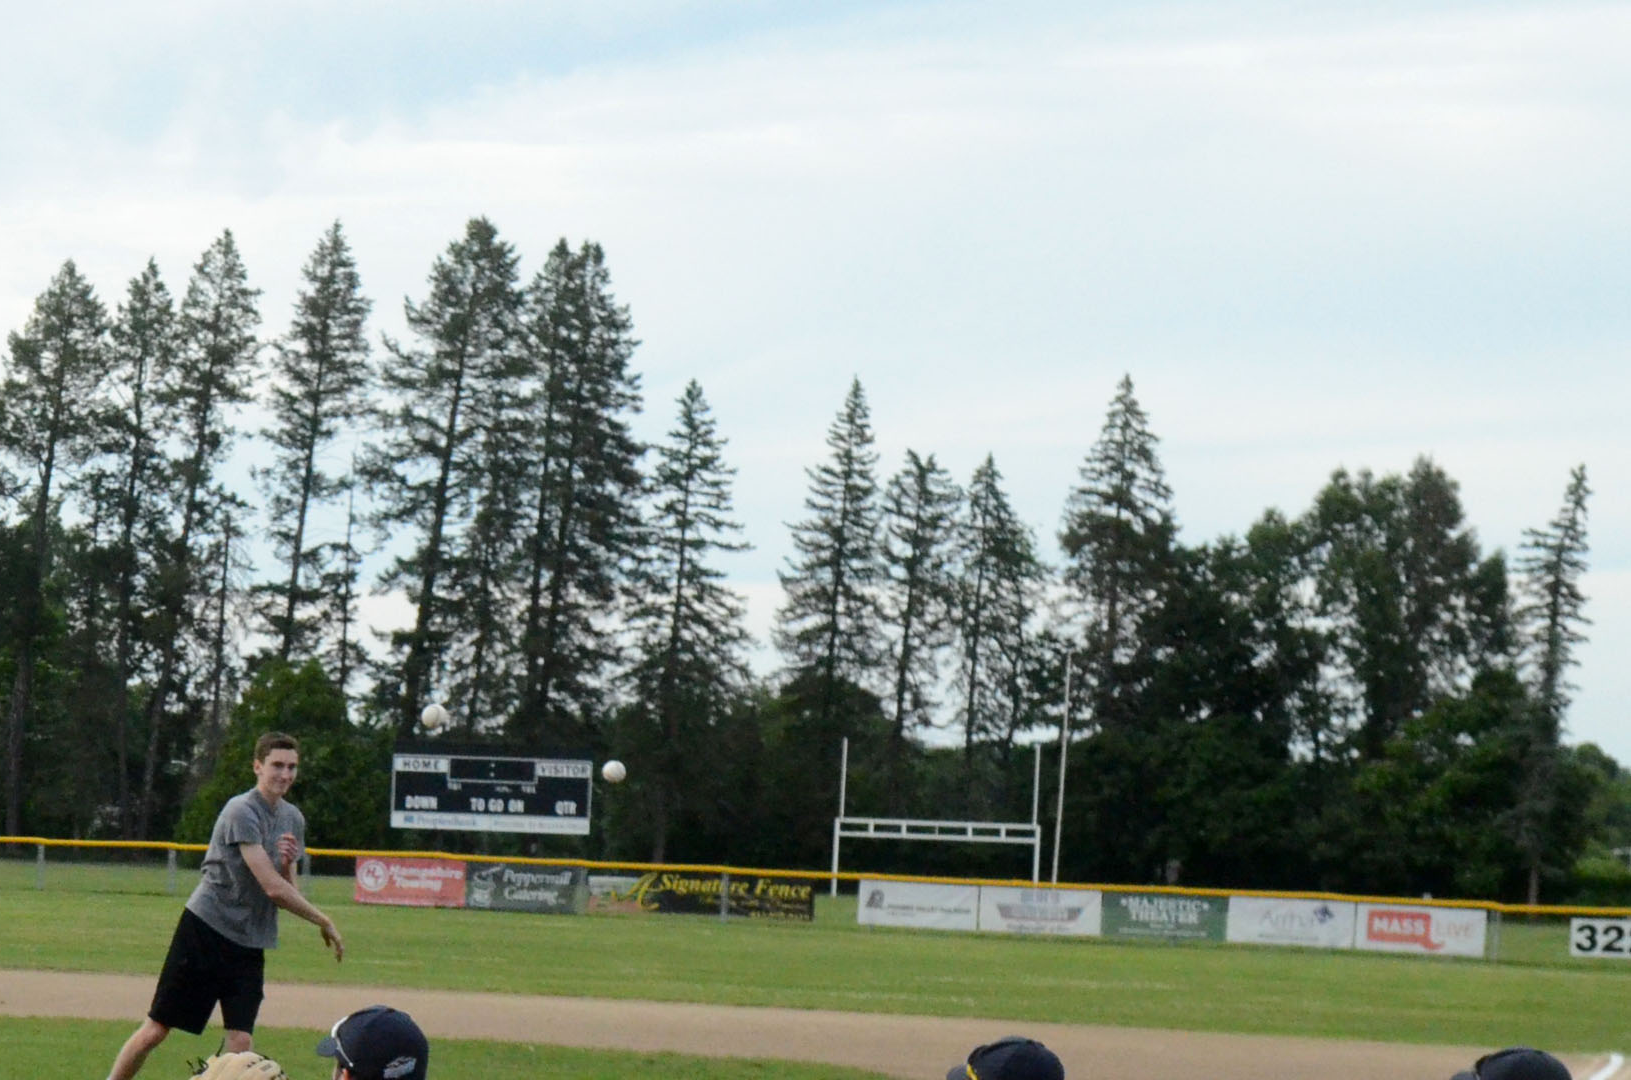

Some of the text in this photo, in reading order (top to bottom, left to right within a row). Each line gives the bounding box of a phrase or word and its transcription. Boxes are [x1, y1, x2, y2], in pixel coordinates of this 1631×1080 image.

[403, 760, 440, 770] HOME
[540, 764, 588, 775] VISITOR
[470, 797, 485, 812] TO
[554, 800, 577, 816] QTR
[660, 873, 812, 900] Signatre Fence
[1373, 915, 1426, 936] MASS
[1576, 924, 1631, 952] 32
